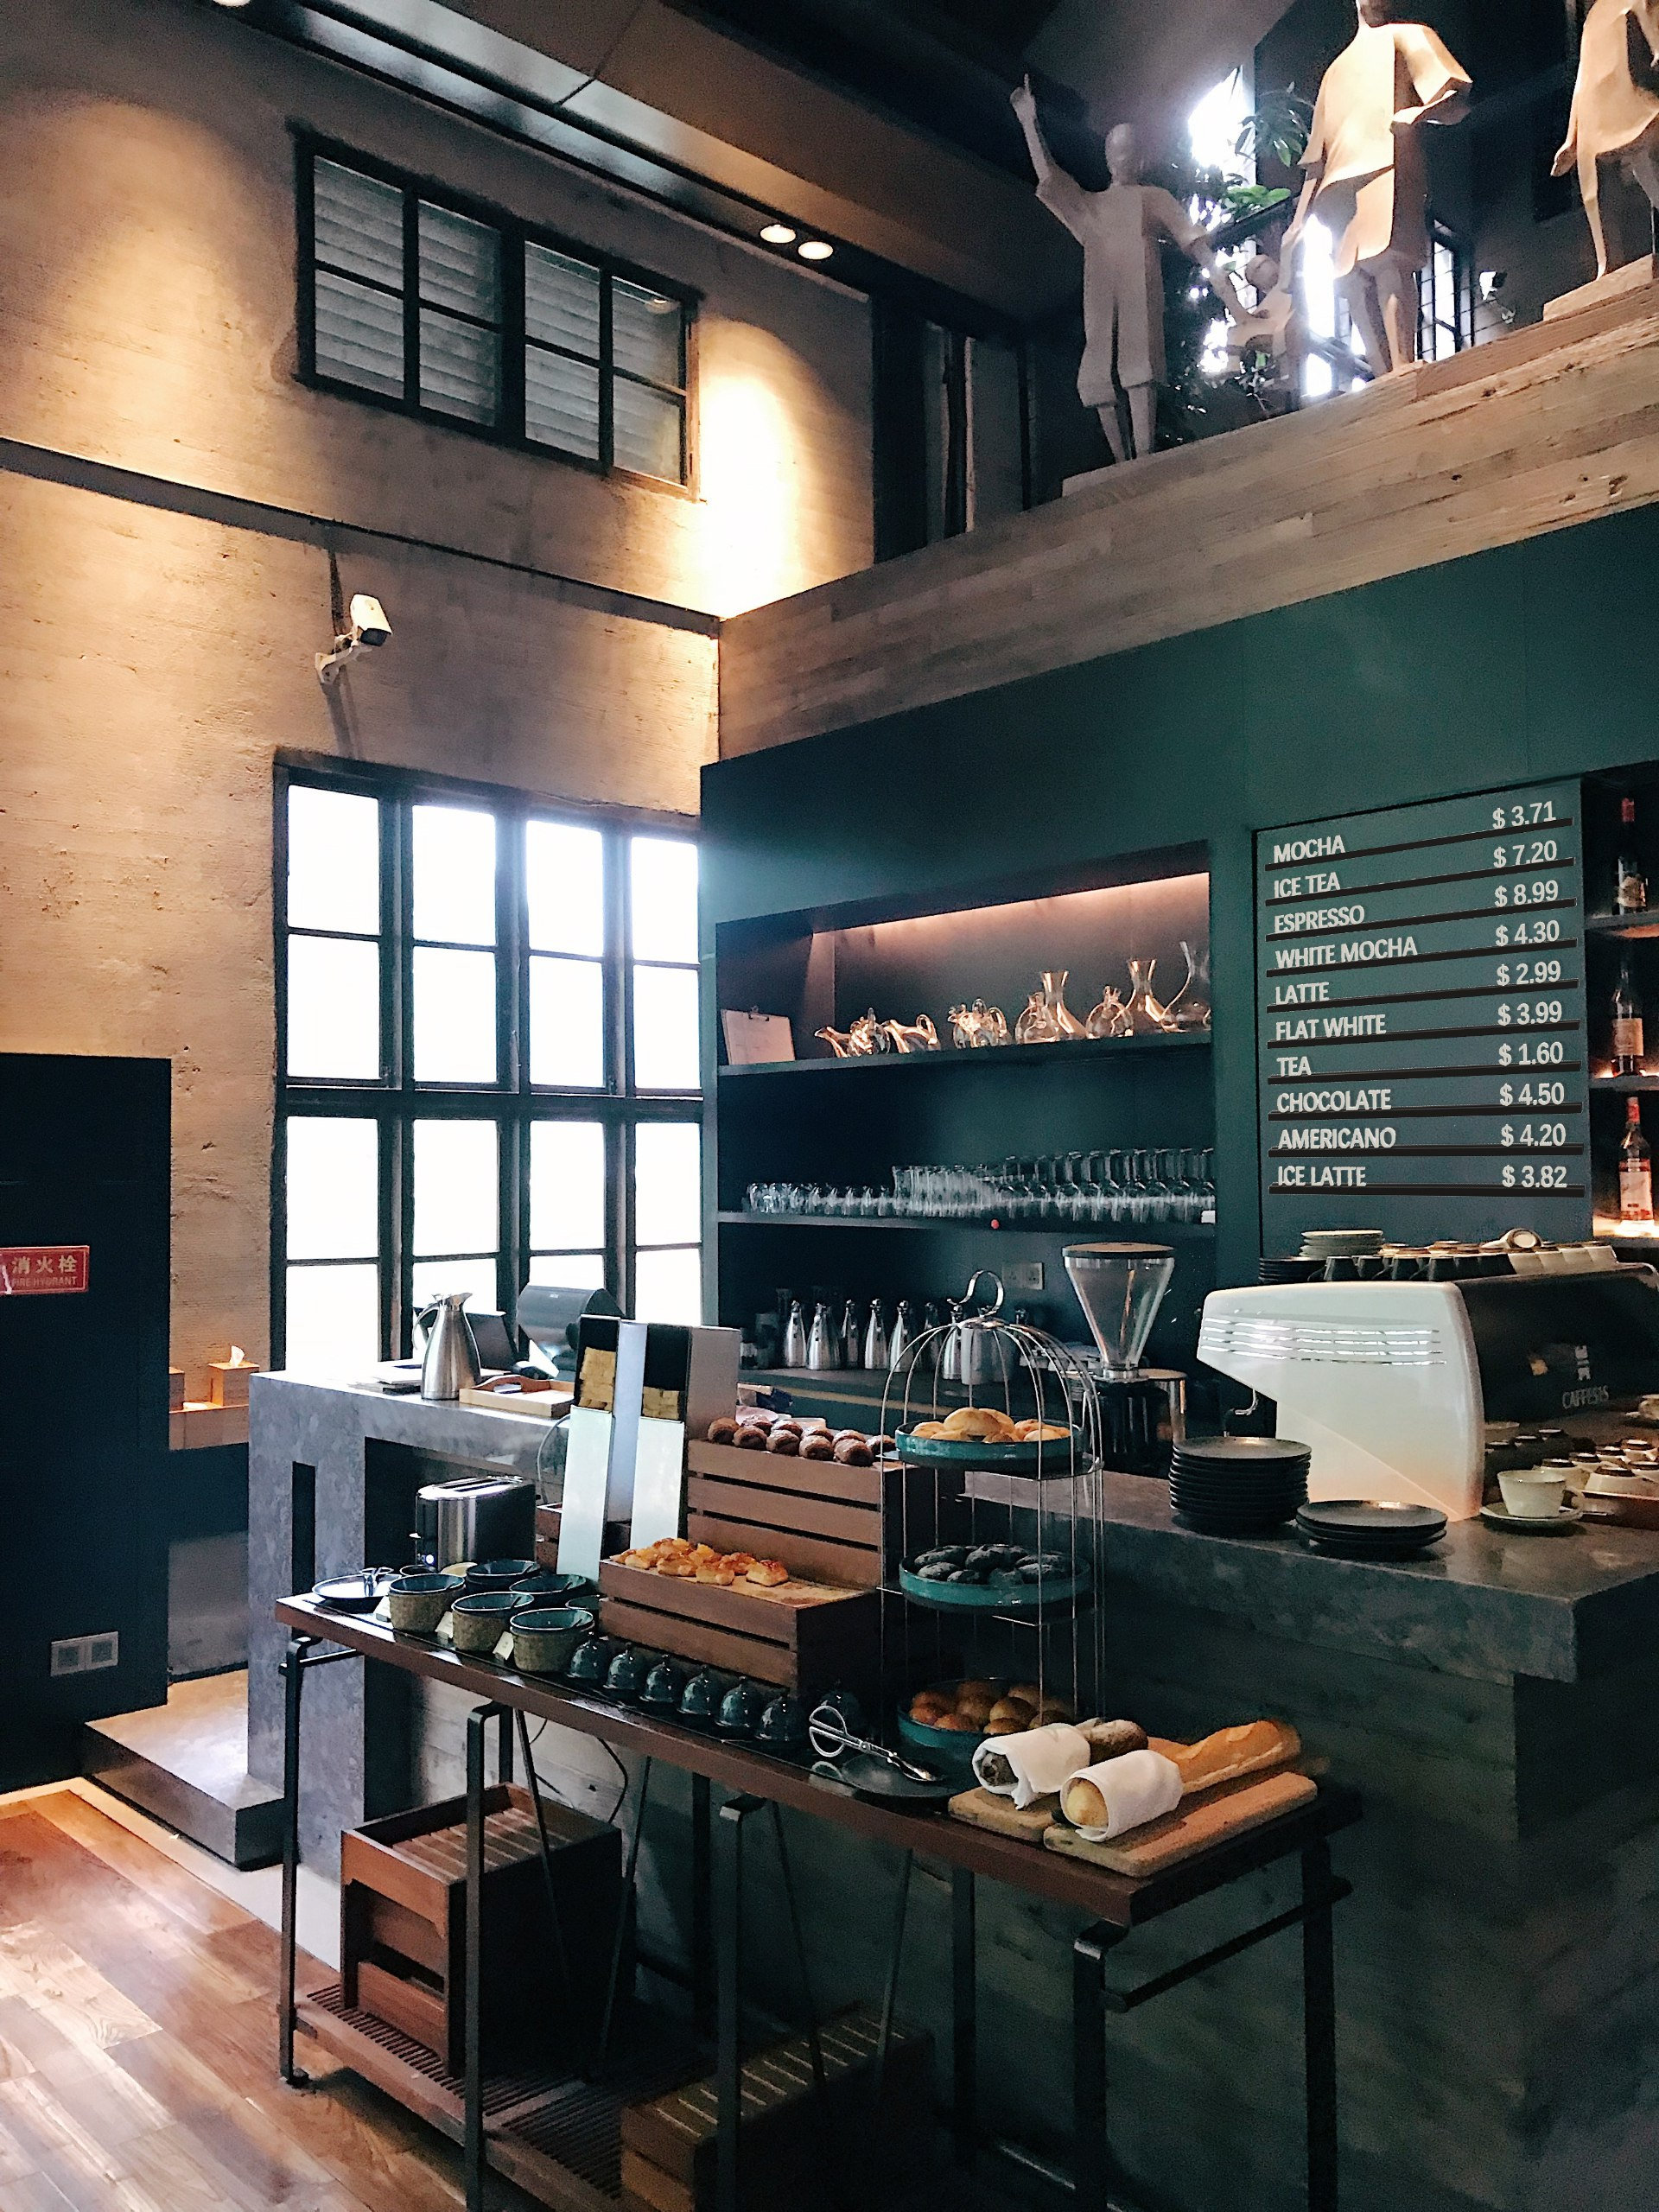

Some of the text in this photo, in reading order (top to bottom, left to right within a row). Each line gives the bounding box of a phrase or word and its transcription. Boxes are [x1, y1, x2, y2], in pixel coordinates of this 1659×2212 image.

[1274, 835, 1346, 863] MOCHA
[1274, 876, 1302, 899] ICE
[1305, 872, 1341, 894] TEA
[1274, 905, 1365, 933] ESPRESSO
[1275, 944, 1337, 969] WHITE
[1341, 936, 1418, 963] MOCHA
[1275, 982, 1330, 1006] LATTE
[1275, 1019, 1319, 1040] FLAT
[1323, 1014, 1387, 1038] WHITE
[1276, 1056, 1312, 1077] TEA
[1277, 1089, 1392, 1113] CHOCOLATE
[1278, 1127, 1396, 1149] AMERICANO
[1278, 1166, 1306, 1186] ICE
[1311, 1166, 1367, 1186] LATTE
[11, 1255, 78, 1274] 消火栓
[33, 1276, 78, 1287] HYDRANT
